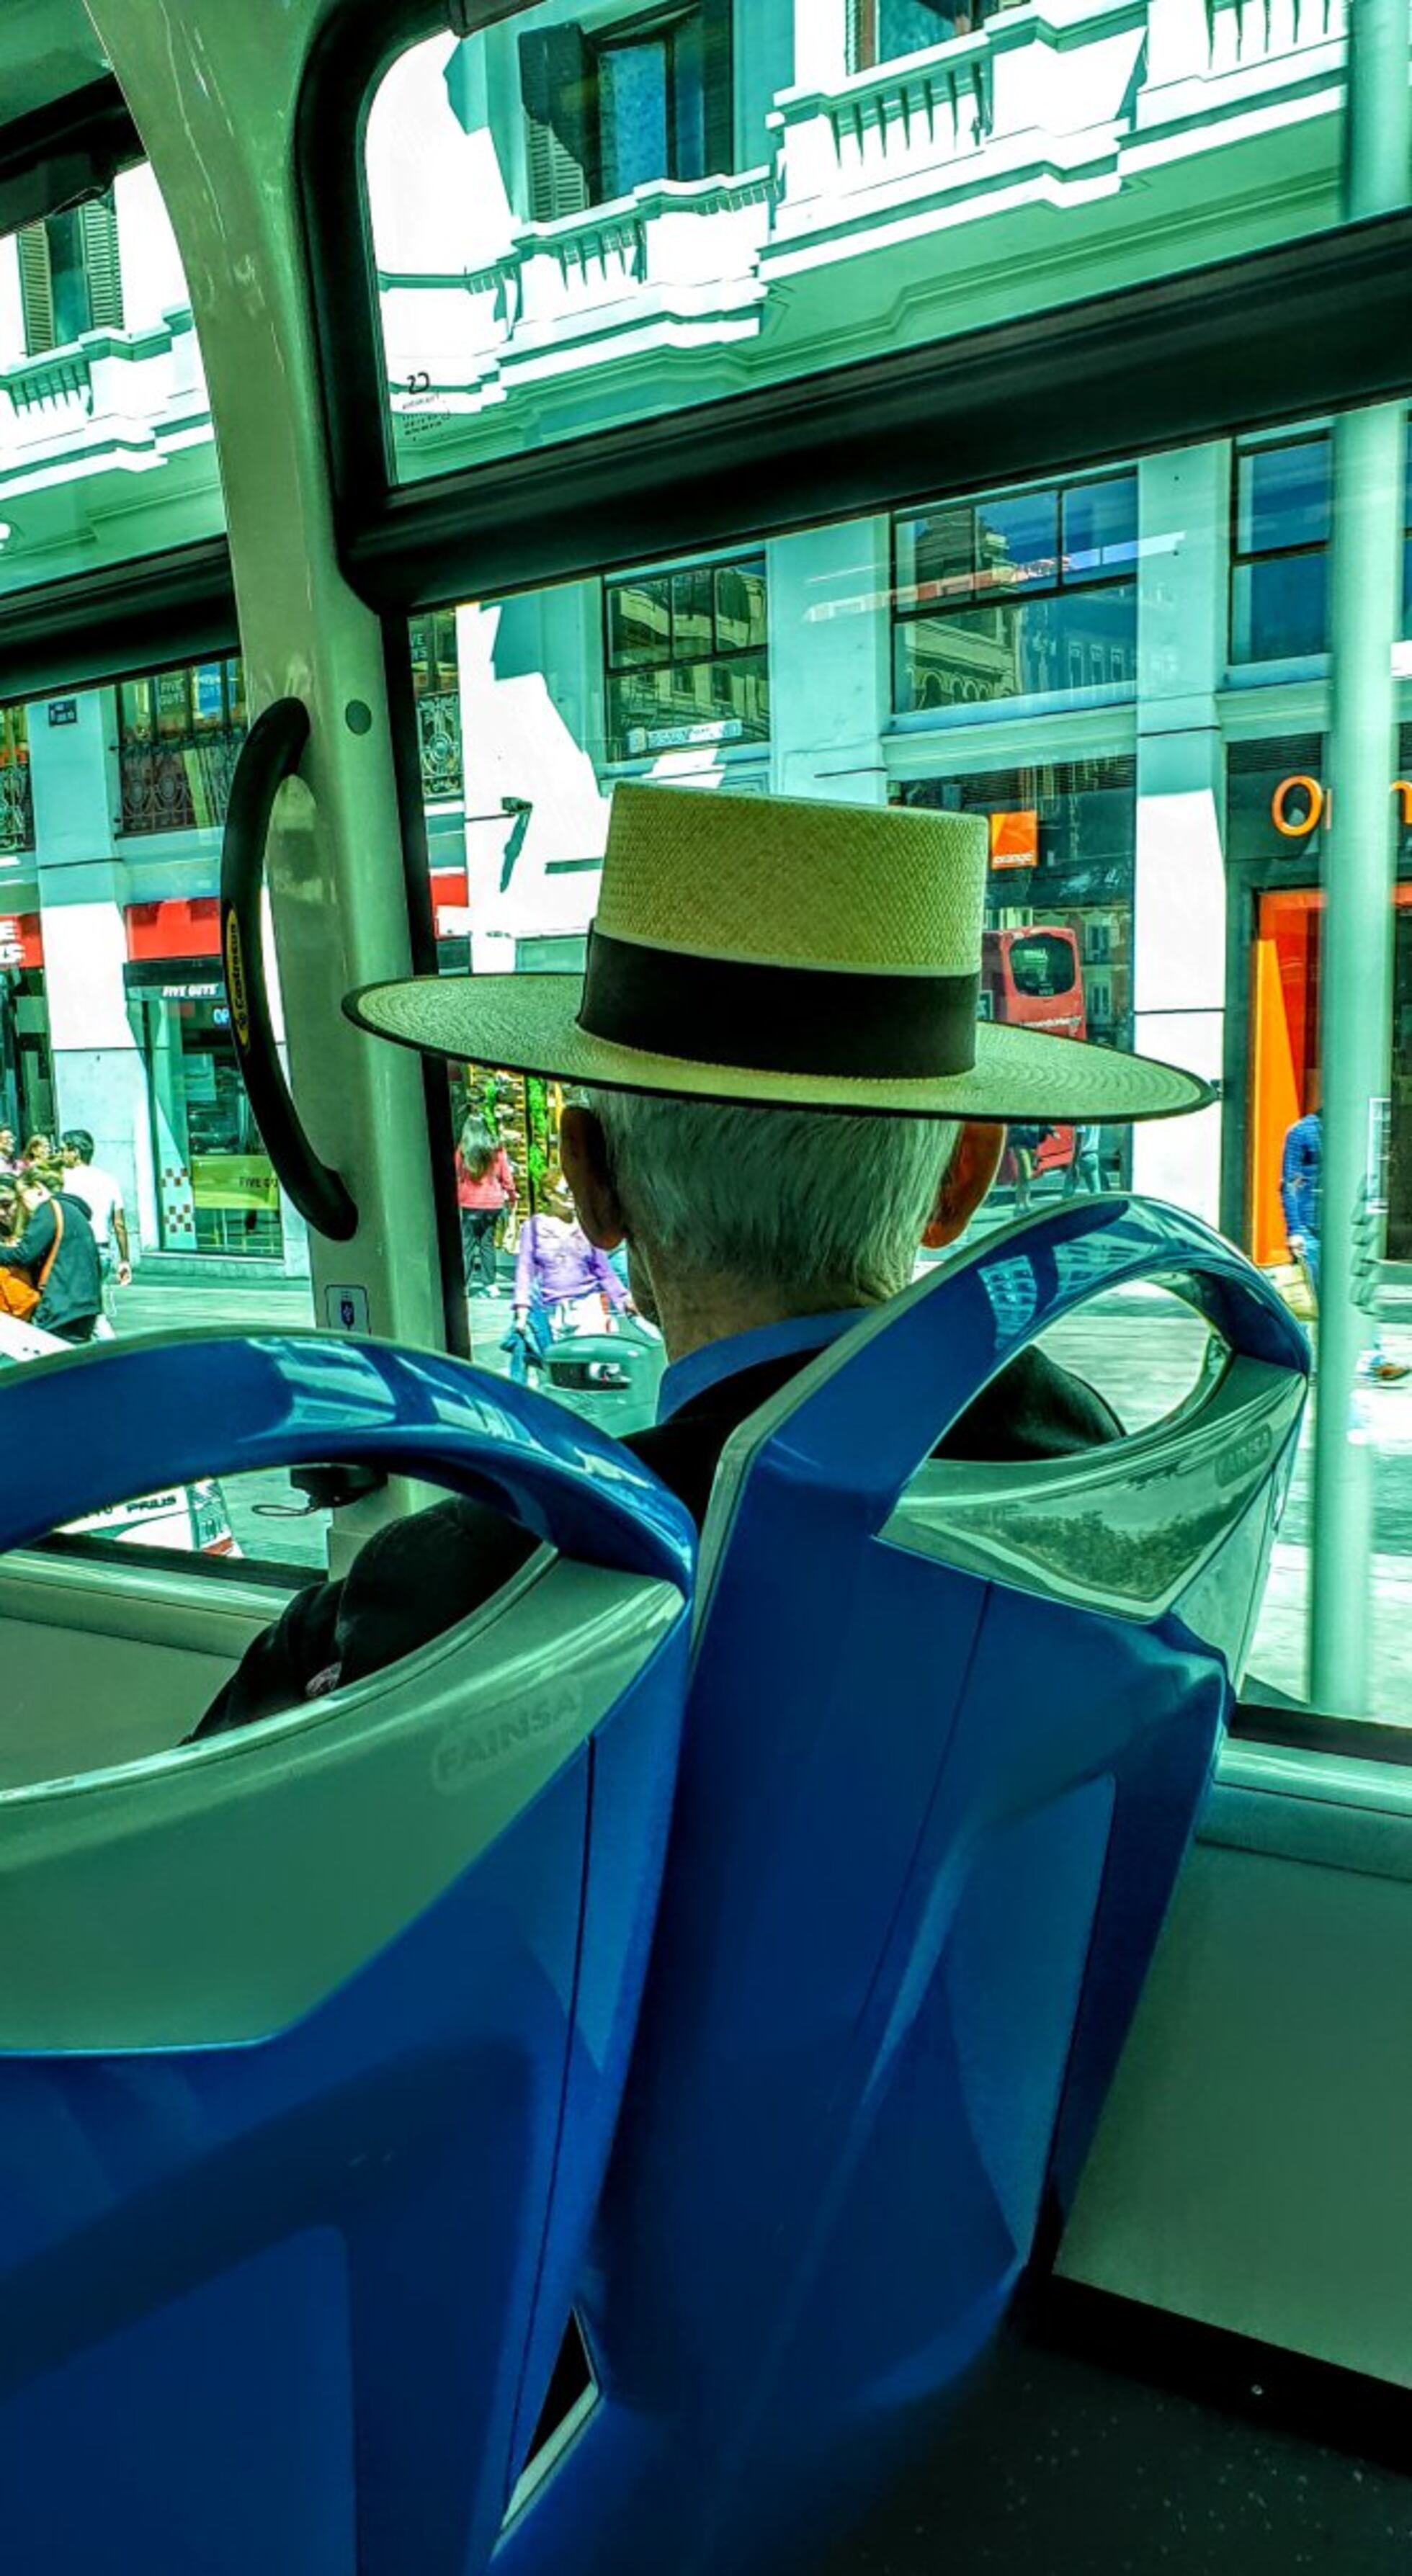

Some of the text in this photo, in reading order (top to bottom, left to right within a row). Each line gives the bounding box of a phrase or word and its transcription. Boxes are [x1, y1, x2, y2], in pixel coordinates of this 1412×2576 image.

[162, 983, 219, 998] FIVE GUYS
[239, 1176, 261, 1188] FIVE
[127, 1495, 176, 1512] PRIUS
[437, 1691, 578, 1781] FAINSA
